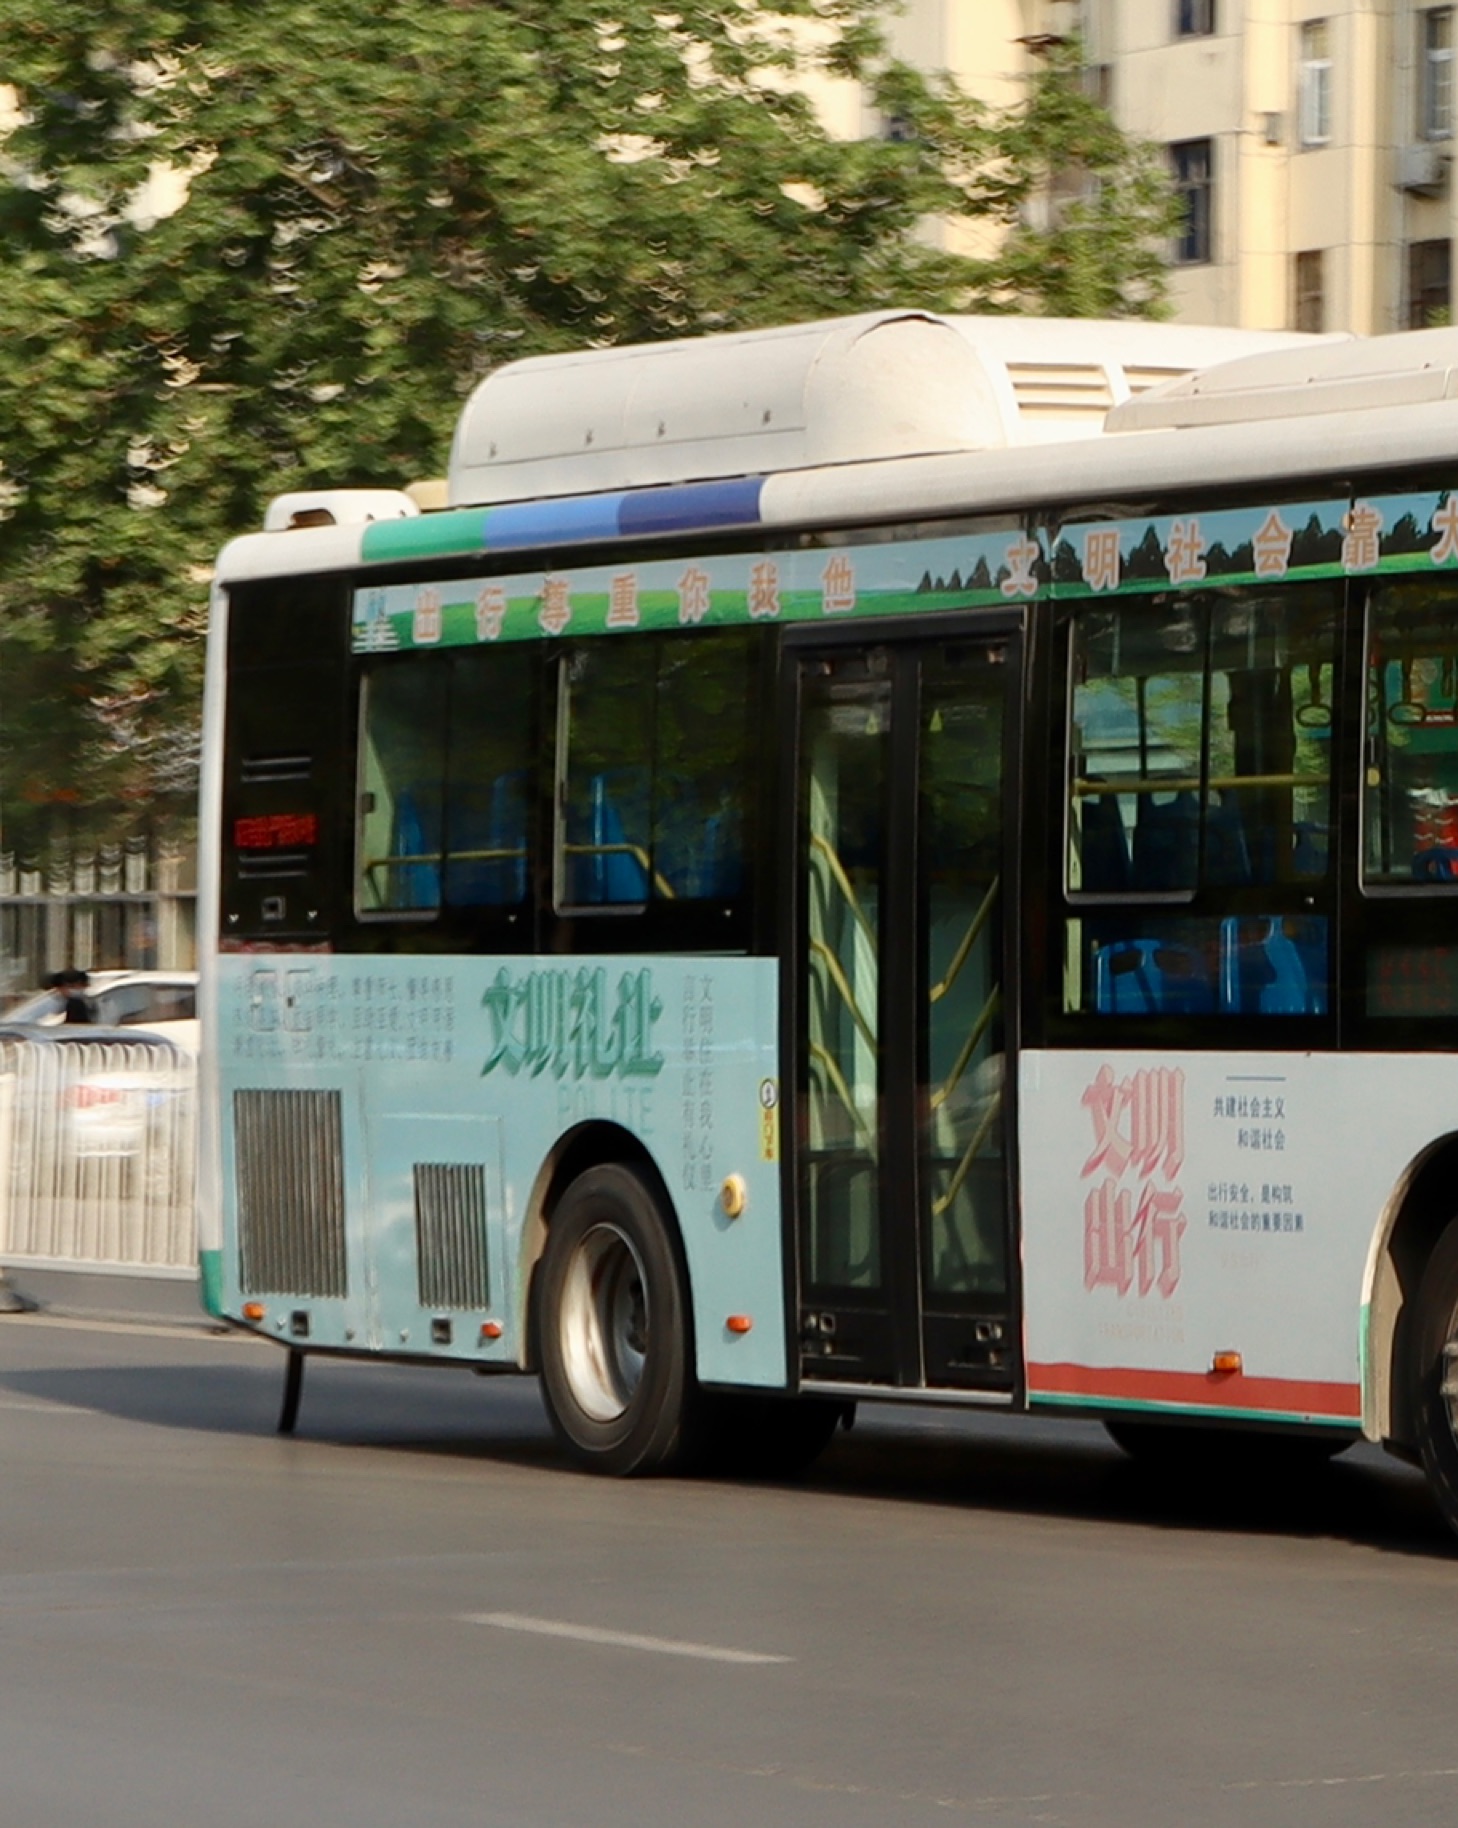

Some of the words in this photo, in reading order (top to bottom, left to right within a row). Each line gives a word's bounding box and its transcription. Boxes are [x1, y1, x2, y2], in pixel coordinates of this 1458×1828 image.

[411, 554, 857, 645] 出行尊重你我他
[481, 965, 665, 1081] 文明礼让
[1080, 1063, 1186, 1182] 文明
[1213, 1096, 1286, 1119] 共建社会主义
[1237, 1127, 1286, 1151] 和谐社会
[1083, 1177, 1188, 1299] 出行
[1208, 1210, 1305, 1232] 和谐社会的重要因素
